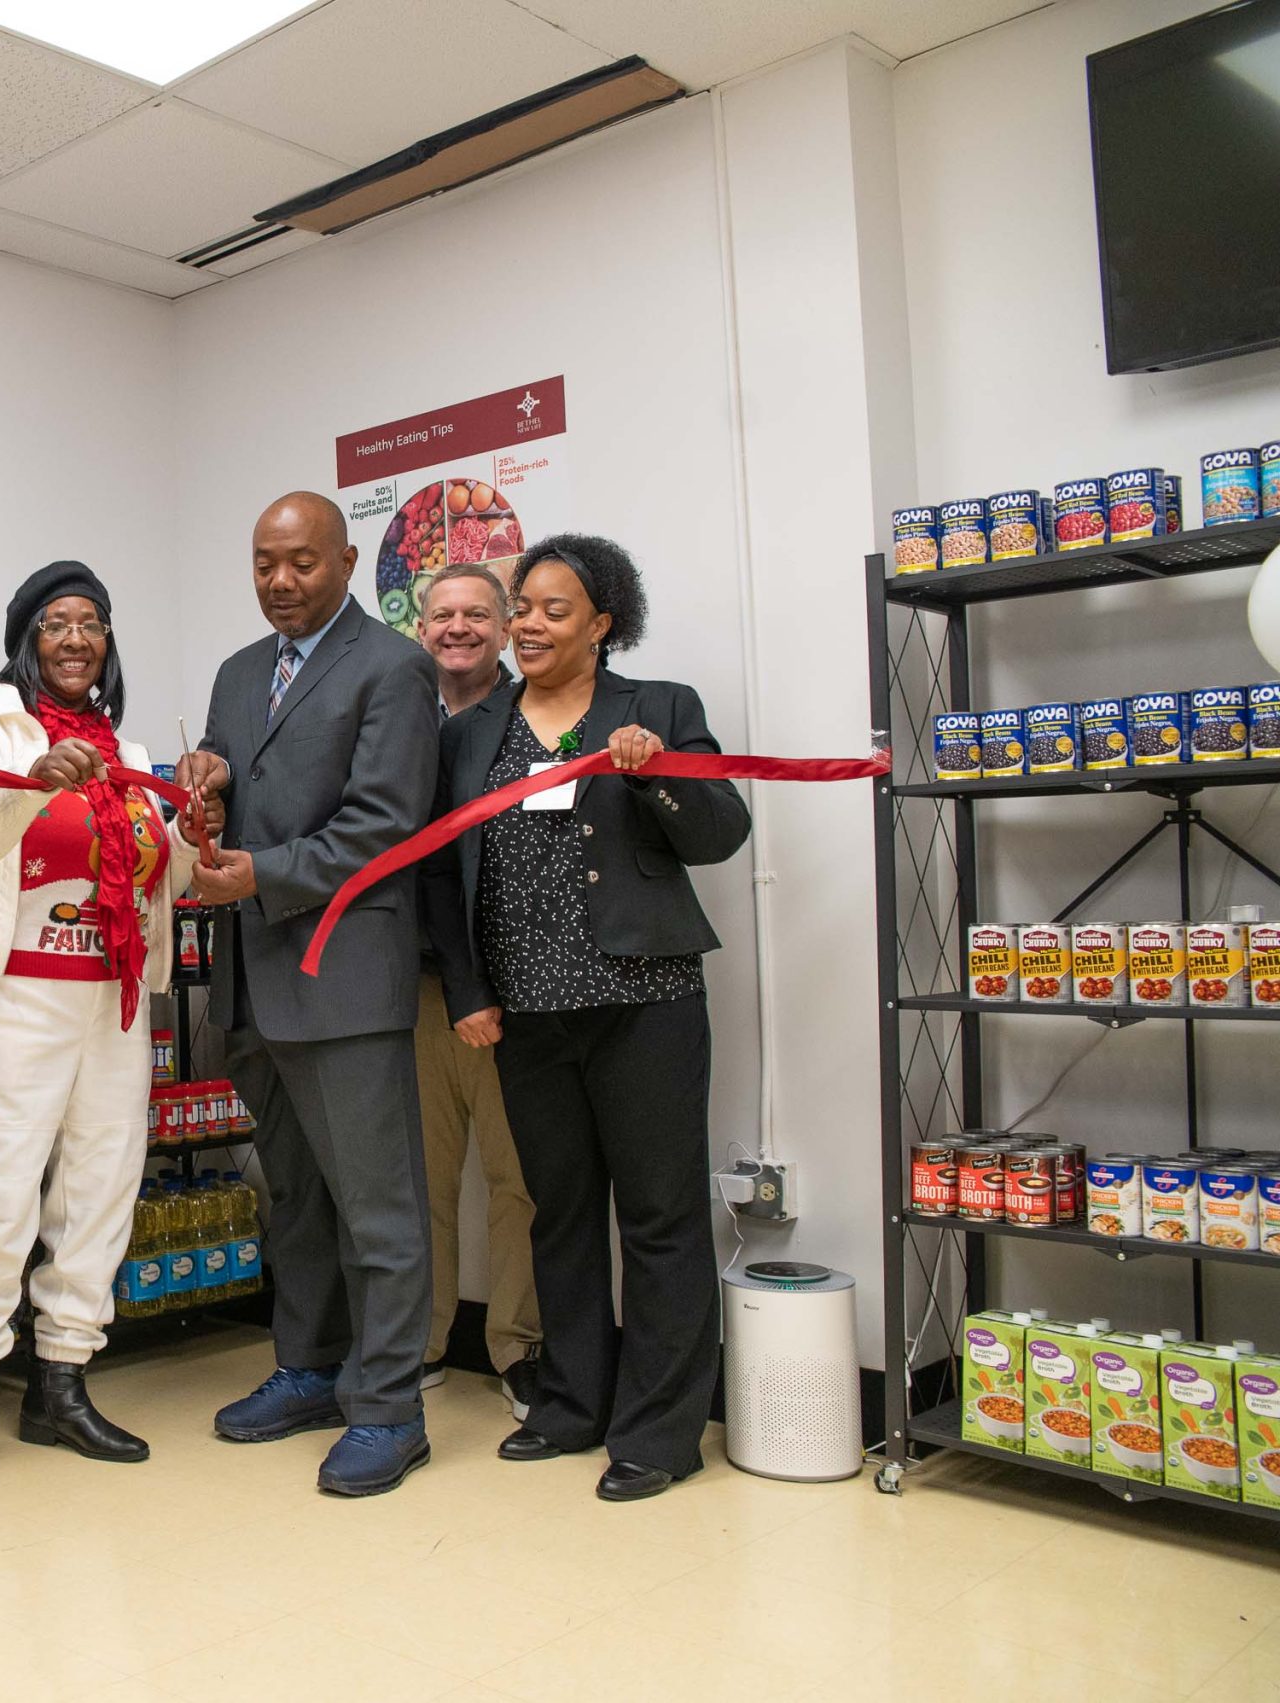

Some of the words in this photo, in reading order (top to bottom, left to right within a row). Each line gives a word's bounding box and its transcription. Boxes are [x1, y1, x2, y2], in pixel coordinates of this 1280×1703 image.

[356, 437, 394, 456] Healthy
[397, 430, 428, 447] Eating
[431, 422, 453, 437] Tips
[1262, 445, 1280, 461] GO
[499, 457, 515, 466] 25%
[1204, 452, 1251, 470] GOYA
[499, 458, 548, 477] Protein-rich
[499, 474, 524, 487] Foods
[375, 486, 392, 496] 50%
[353, 499, 376, 511] Fruits
[378, 495, 393, 505] and
[990, 494, 1031, 511] GOYA
[349, 504, 393, 521] Vegetables
[941, 503, 981, 519] GOYA
[893, 510, 932, 526] GOYA
[1194, 691, 1242, 707] GOYA
[1251, 686, 1280, 703] GOY
[1133, 696, 1175, 712] GOYA
[1028, 707, 1068, 723] GOYA
[937, 716, 978, 730] GOYA
[973, 938, 1004, 947] CHUNKY
[1024, 938, 1057, 947] CHUNKY
[1076, 938, 1109, 947] CHUNKY
[1134, 938, 1168, 947] CHUNKY
[1190, 938, 1223, 947] CHUNKY
[1252, 938, 1280, 947] CHUNK
[972, 953, 1008, 965] CHILI
[1023, 954, 1061, 966] CHILI
[1075, 954, 1114, 966] CHILI
[1132, 955, 1172, 966] CHILI
[1189, 955, 1228, 967] CHILI
[1252, 956, 1280, 968] CHIL
[976, 965, 988, 973] WITH
[989, 964, 1009, 972] BEANS
[1041, 965, 1062, 973] BEANS
[1094, 965, 1115, 973] BEANS
[1152, 966, 1174, 974] BEANS
[1192, 968, 1206, 976] WITH
[1207, 966, 1230, 974] BEANS
[1255, 968, 1270, 976] WITH
[166, 1106, 183, 1126] Ji
[186, 1103, 204, 1124] Ji
[915, 1186, 949, 1199] BROTH
[961, 1191, 996, 1205] BROTH
[970, 1331, 994, 1341] Organic
[1032, 1344, 1058, 1353] Organic
[1096, 1356, 1122, 1366] Organic
[1167, 1367, 1195, 1377] Organic
[1102, 1377, 1121, 1385] Broth
[1242, 1379, 1274, 1388] Organic
